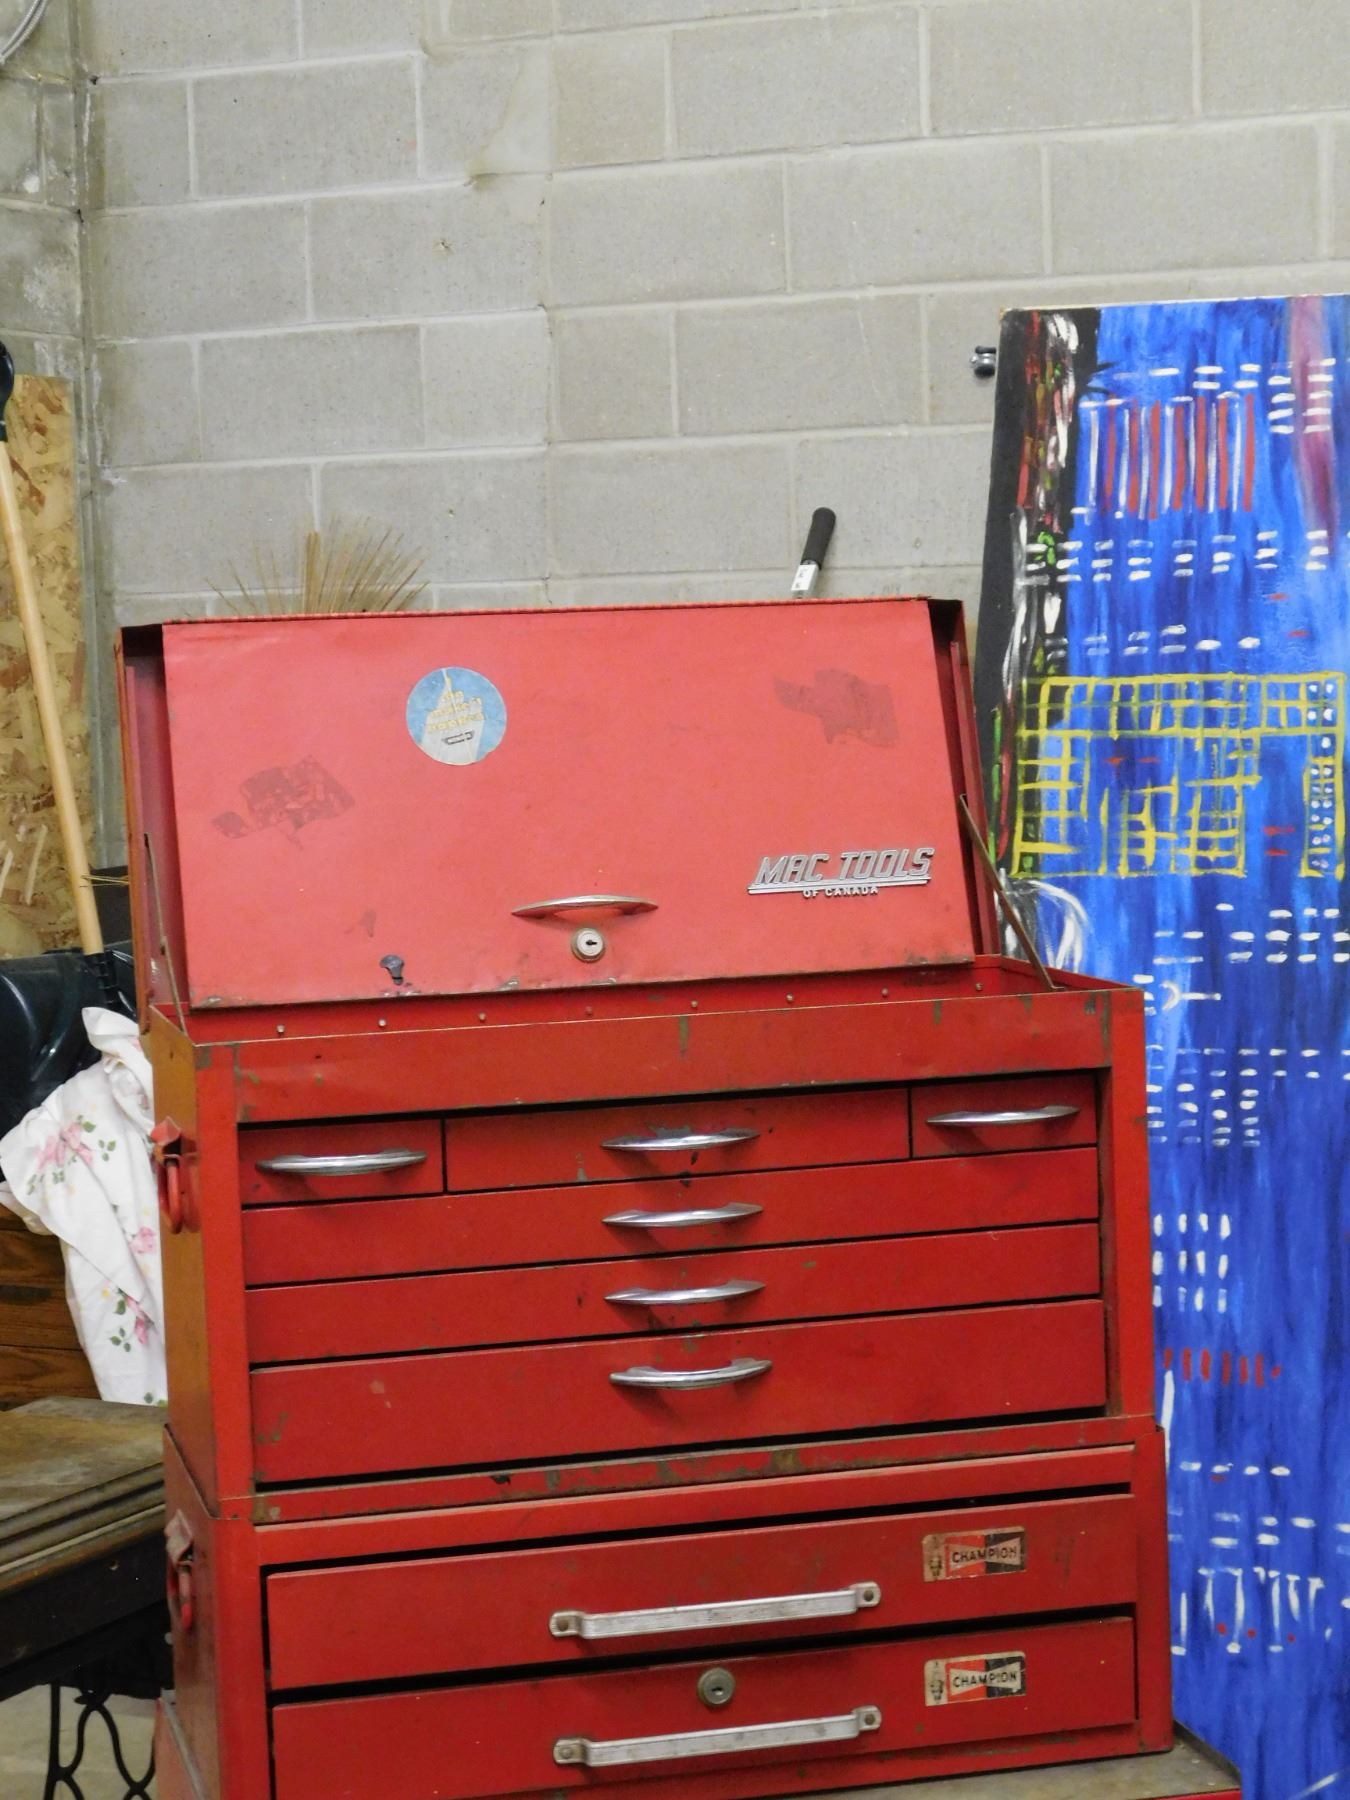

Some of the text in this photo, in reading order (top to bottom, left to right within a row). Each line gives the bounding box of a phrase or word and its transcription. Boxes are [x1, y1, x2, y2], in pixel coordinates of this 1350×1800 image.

[753, 847, 935, 885] MAC TOOLS
[803, 886, 879, 898] OF CANADA
[953, 1547, 1018, 1564] CHAMPION
[952, 1670, 1018, 1688] CHAMPION
